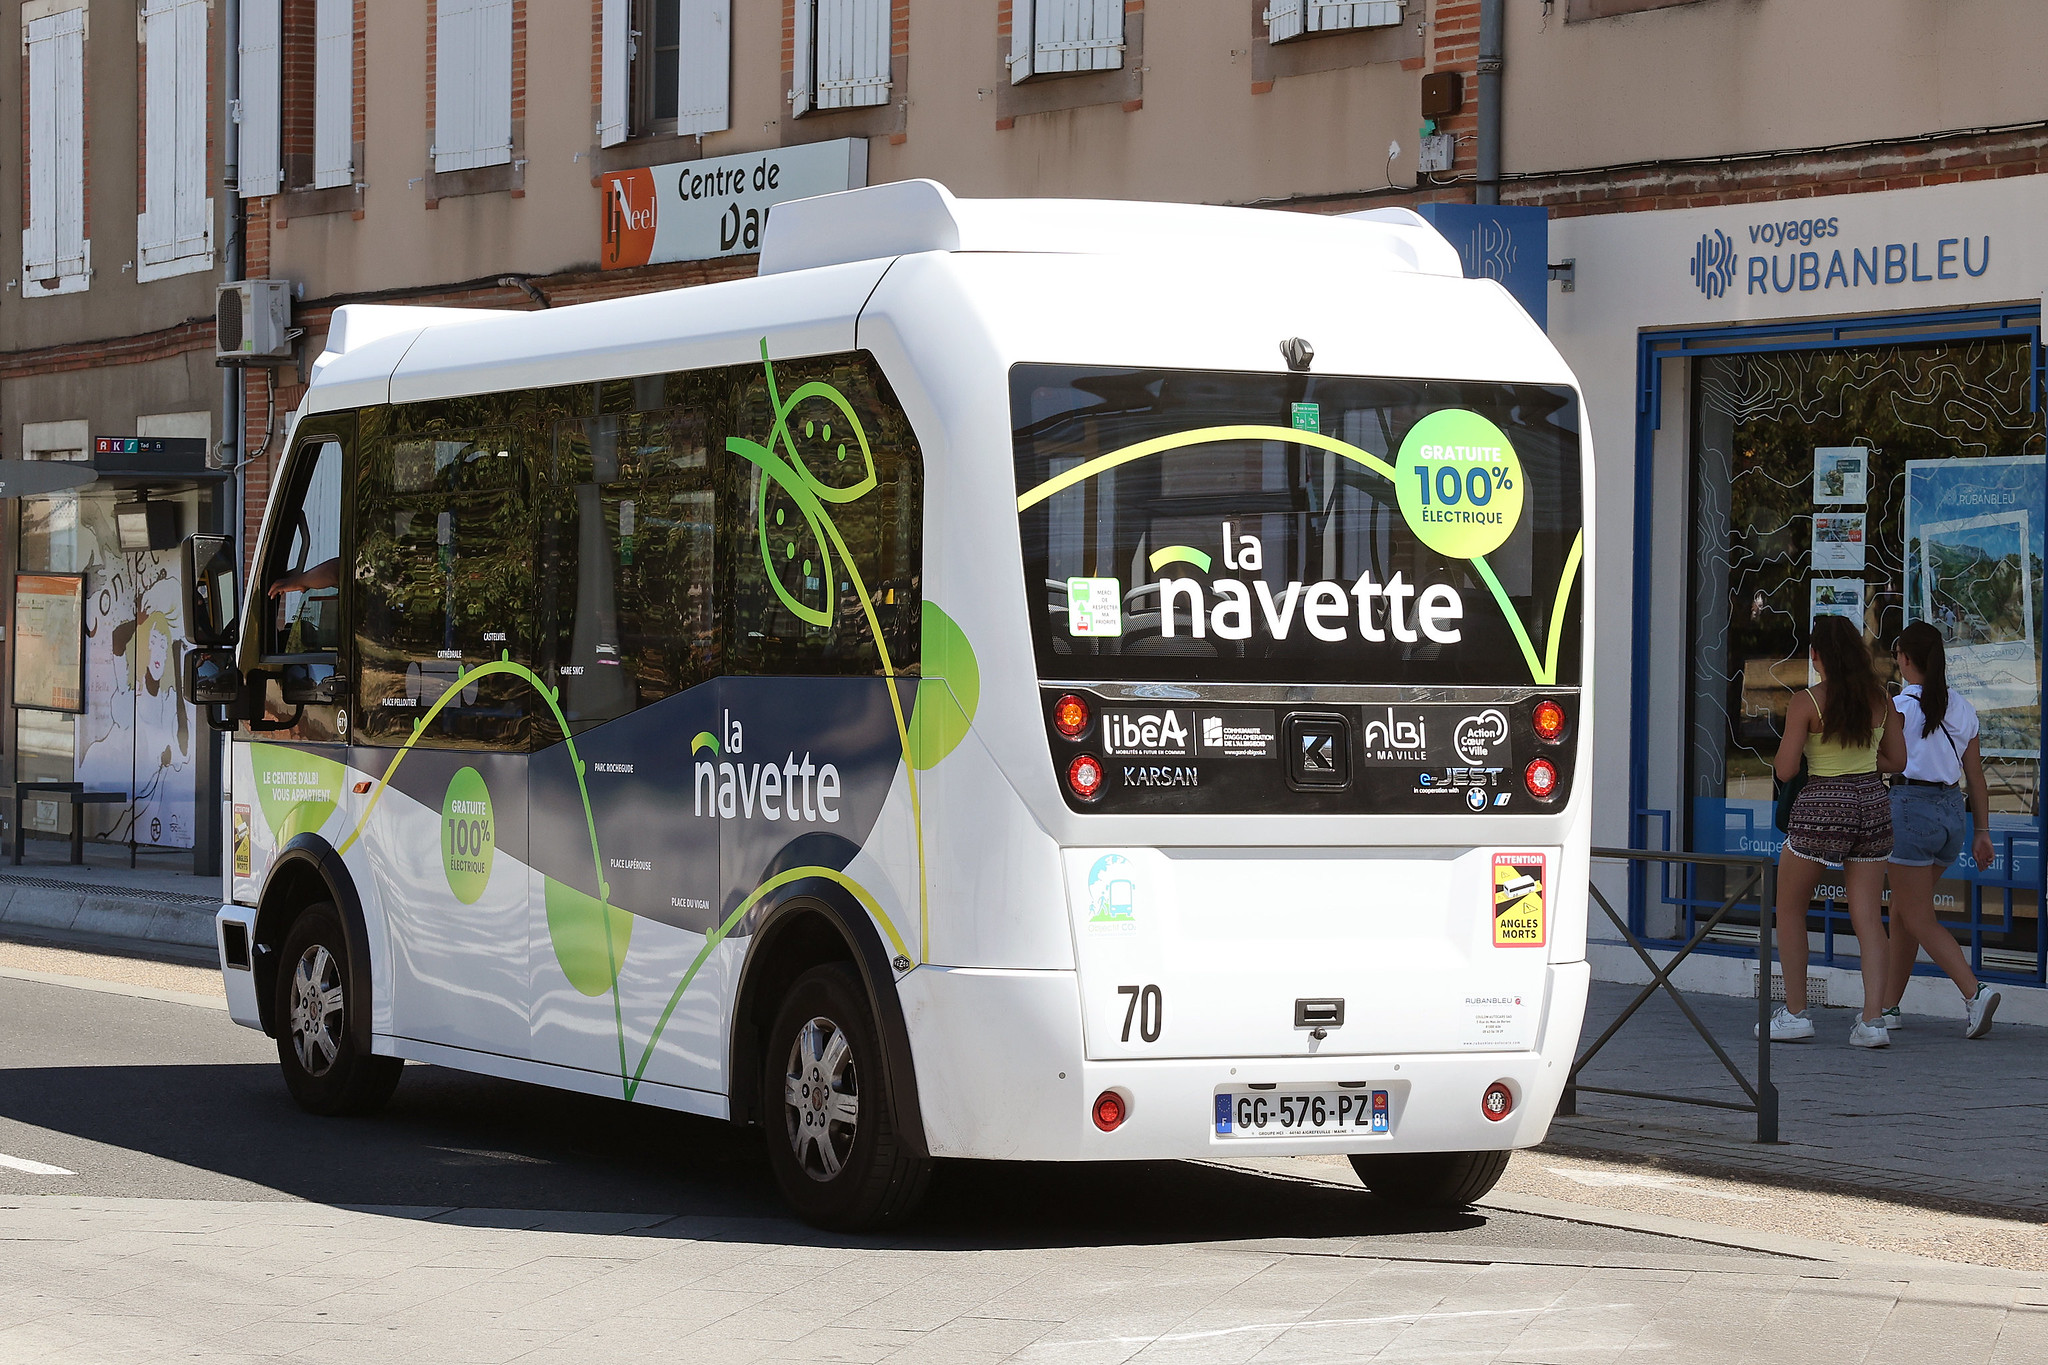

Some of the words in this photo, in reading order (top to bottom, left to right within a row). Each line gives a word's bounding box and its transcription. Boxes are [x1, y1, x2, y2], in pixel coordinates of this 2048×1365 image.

[678, 166, 746, 201] Centre
[753, 157, 780, 190] de
[611, 177, 657, 233] Neel
[1749, 217, 1839, 247] voyages
[1747, 235, 1990, 295] RUBANBLEU
[1420, 444, 1502, 462] GRATUITE
[1414, 465, 1513, 506] 100%
[1959, 493, 2016, 505] RUBANBLEU
[1422, 506, 1503, 525] ÉLECTRIQUE
[1222, 521, 1262, 571] la
[1160, 570, 1464, 644] navette
[560, 666, 573, 676] GARE
[574, 666, 584, 676] SNCF
[724, 708, 743, 753] la
[1467, 728, 1495, 738] Action
[1377, 750, 1394, 761] MA
[1395, 750, 1427, 761] VILLE
[1468, 745, 1488, 756] Ville
[594, 762, 605, 772] PARC
[606, 762, 634, 774] ROCHEGUDE
[1123, 766, 1198, 786] KARSAN
[1420, 767, 1504, 786] e-JEST
[263, 771, 271, 785] LE
[272, 772, 297, 785] CENTRE
[299, 772, 319, 785] D'ALBI
[694, 751, 841, 823] navette
[272, 788, 290, 801] VOUS
[292, 788, 331, 802] APPARTIENT
[451, 799, 486, 816] GRATUITE
[448, 818, 491, 857] 100%
[1739, 835, 1783, 856] Groupe
[450, 856, 485, 875] ÉLECTRIQUE
[611, 858, 624, 868] PLACE
[625, 857, 652, 871] LAPÉROUSE
[1495, 855, 1543, 864] ATTENTION
[671, 897, 686, 908] PLACE
[687, 898, 693, 908] DU
[694, 899, 710, 910] VIGAN
[1500, 918, 1538, 928] ANGLES
[1502, 929, 1537, 939] MORTS
[1117, 983, 1163, 1043] 70
[1237, 1095, 1369, 1129] GG-576-PZ
[1373, 1112, 1387, 1127] 81
[1221, 1117, 1227, 1126] F
